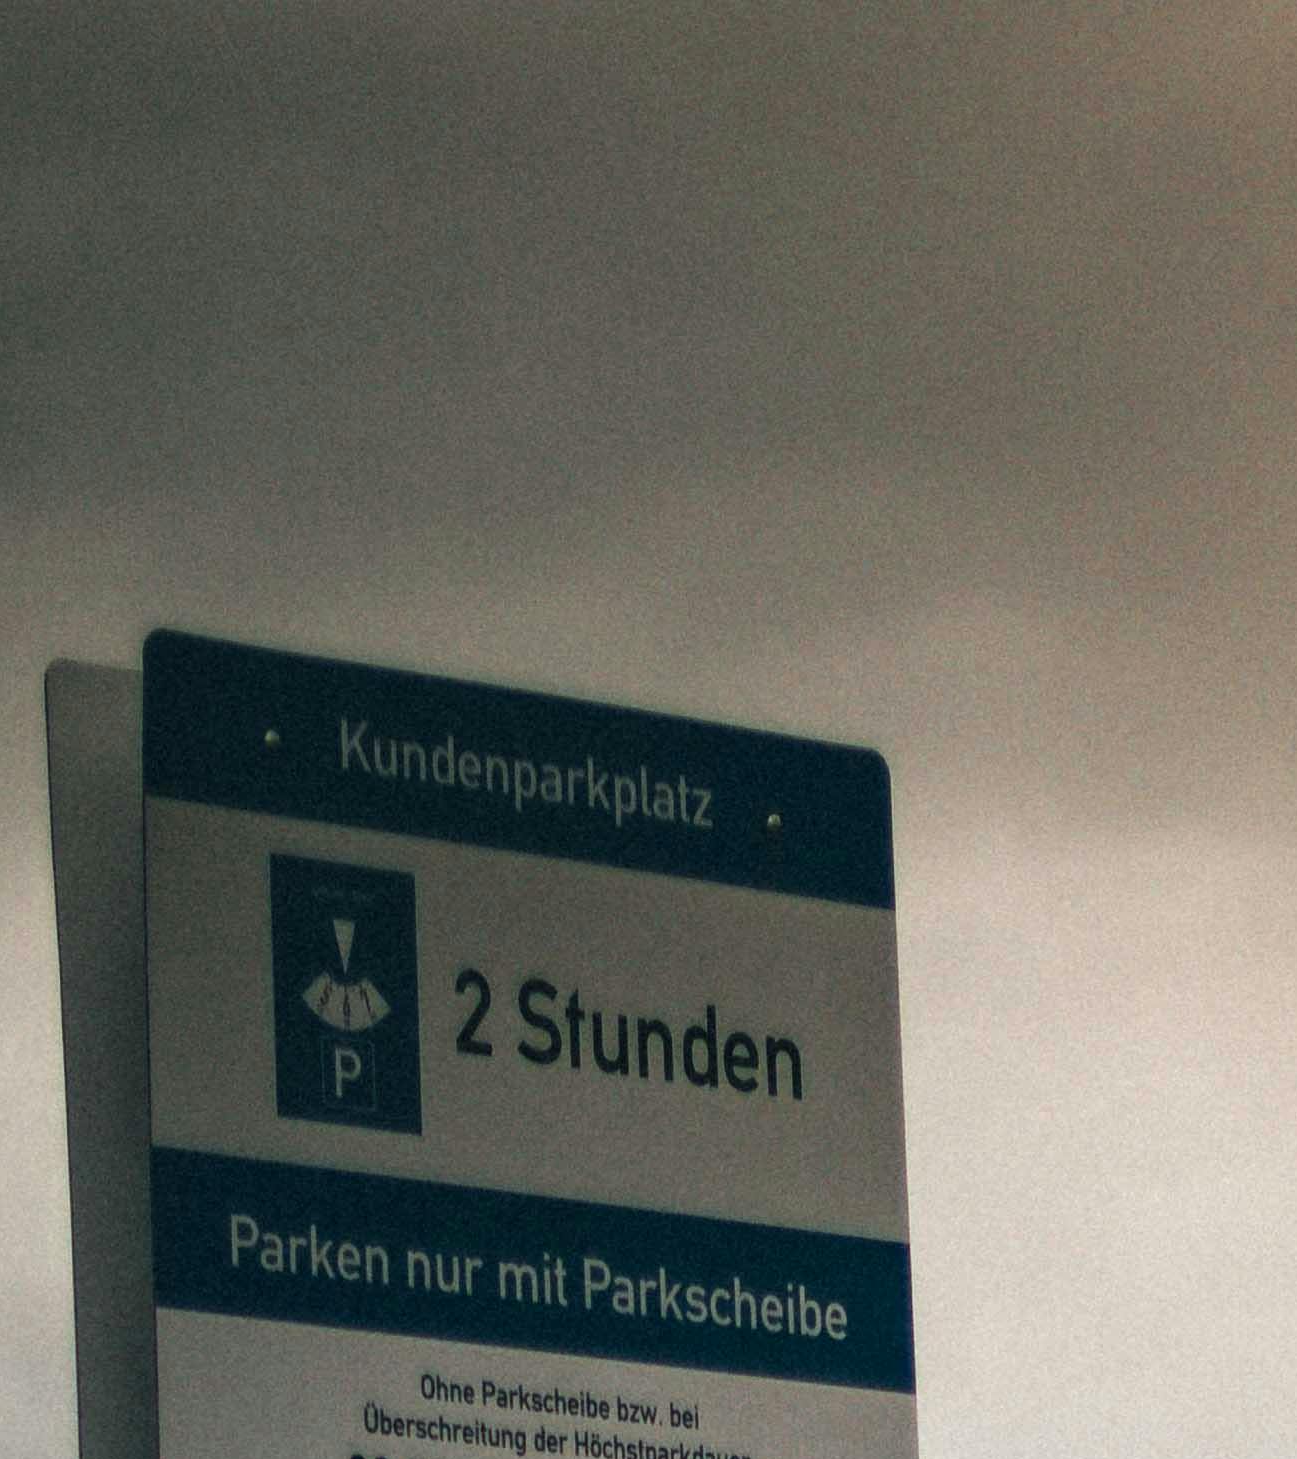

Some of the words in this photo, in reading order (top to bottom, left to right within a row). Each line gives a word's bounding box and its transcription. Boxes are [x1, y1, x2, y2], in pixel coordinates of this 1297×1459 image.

[341, 717, 713, 827] Kundenparkplatz
[335, 1048, 361, 1098] P
[455, 969, 493, 1057] 2
[517, 978, 802, 1100] Stunden
[231, 1214, 389, 1284] Parken
[407, 1249, 479, 1297] nur
[500, 1252, 567, 1308] mit
[583, 1257, 848, 1341] Parkscheibe
[364, 1402, 526, 1456] Überschreitung
[534, 1426, 568, 1454] der
[422, 1374, 474, 1405] Ohne
[482, 1381, 610, 1421] Parkscheibe
[617, 1396, 663, 1428] bzw.
[670, 1402, 699, 1430] bei
